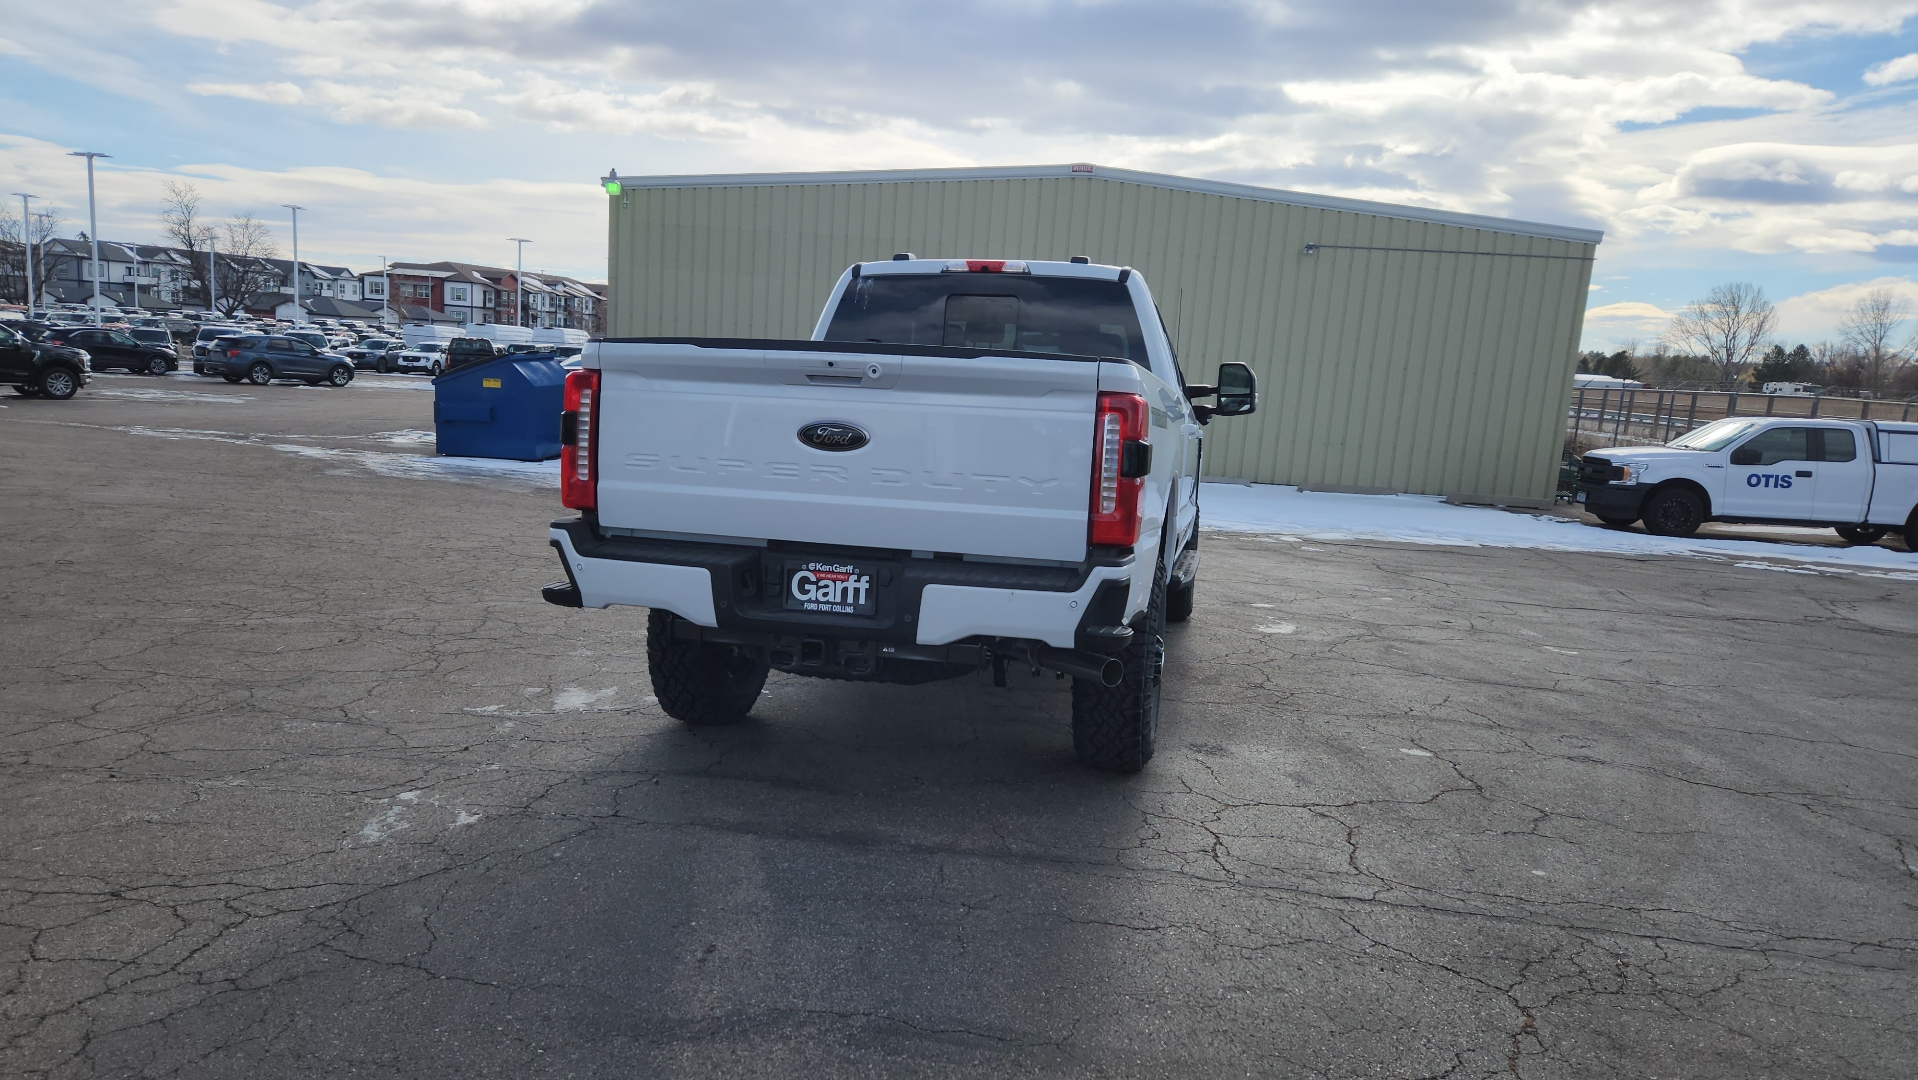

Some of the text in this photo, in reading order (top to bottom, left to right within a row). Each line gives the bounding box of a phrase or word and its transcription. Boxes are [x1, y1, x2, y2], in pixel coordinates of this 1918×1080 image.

[813, 426, 853, 445] Ford
[625, 453, 1059, 495] SUPER DUTY
[1746, 473, 1793, 489] OTIS
[816, 563, 853, 573] Ken Garff
[791, 570, 870, 604] Garff
[804, 602, 854, 614] FORD FORT COLLINS
